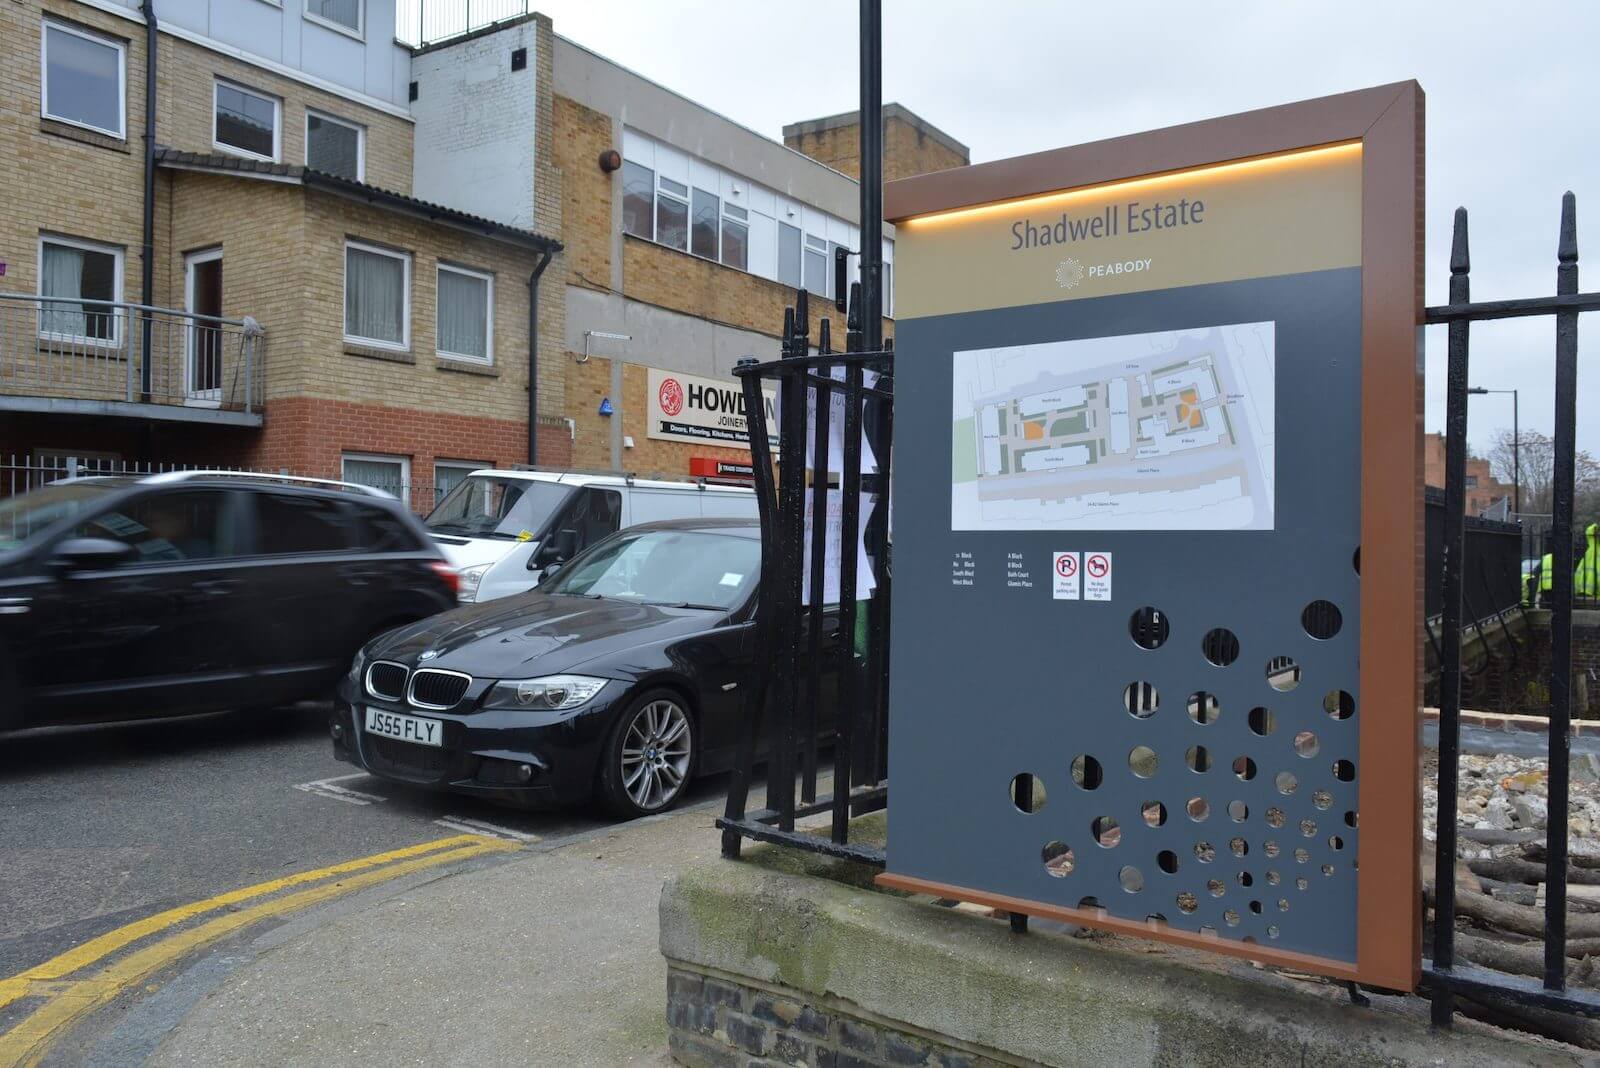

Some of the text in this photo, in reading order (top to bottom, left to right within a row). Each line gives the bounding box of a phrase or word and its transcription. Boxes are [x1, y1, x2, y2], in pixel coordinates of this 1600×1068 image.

[1011, 198, 1205, 251] Shadwell Estate
[1088, 258, 1152, 277] PEABODY
[687, 383, 776, 420] HOWDN
[670, 424, 689, 434] Doors,
[369, 711, 436, 743] JS55 FLY
